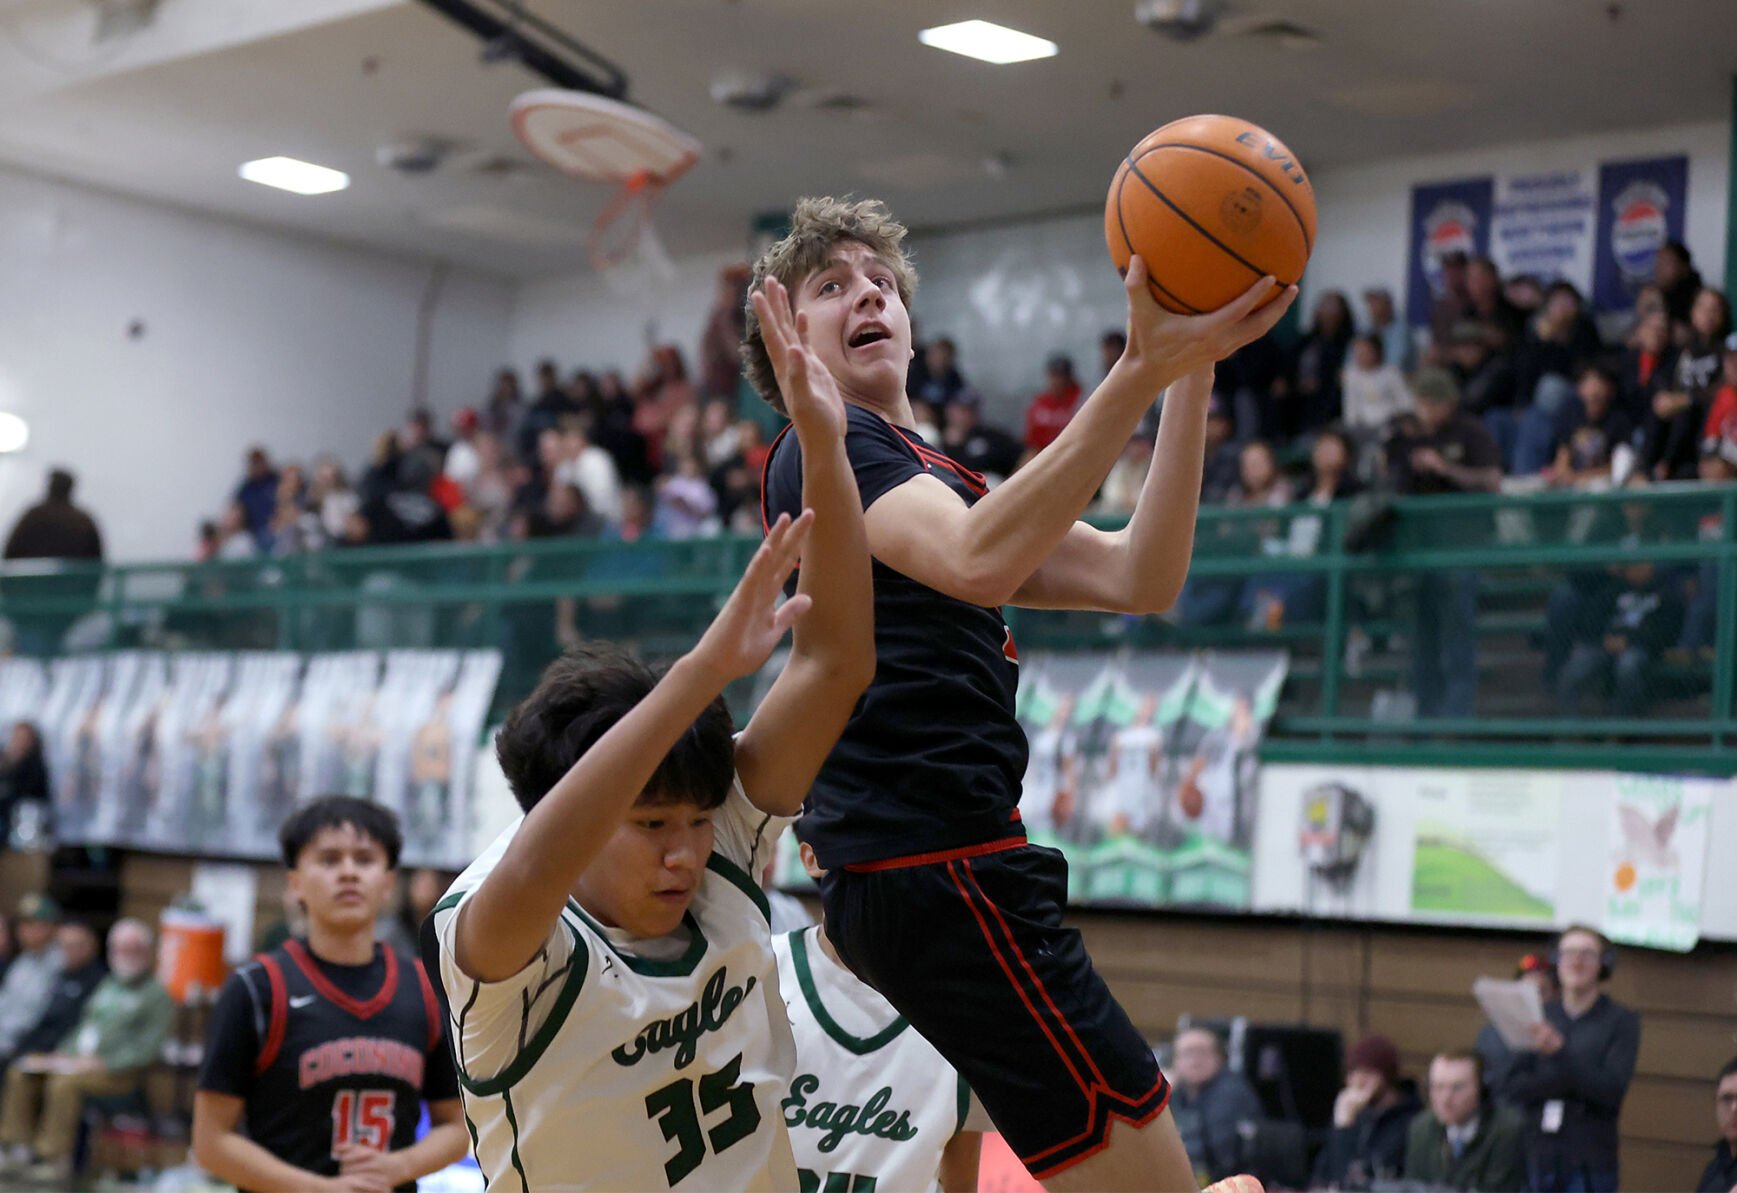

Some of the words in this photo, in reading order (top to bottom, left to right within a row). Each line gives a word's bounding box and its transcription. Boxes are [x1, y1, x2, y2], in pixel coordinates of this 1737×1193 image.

[330, 1088, 396, 1161] 15
[644, 1051, 762, 1188] 35
[780, 1073, 919, 1153] Eagles
